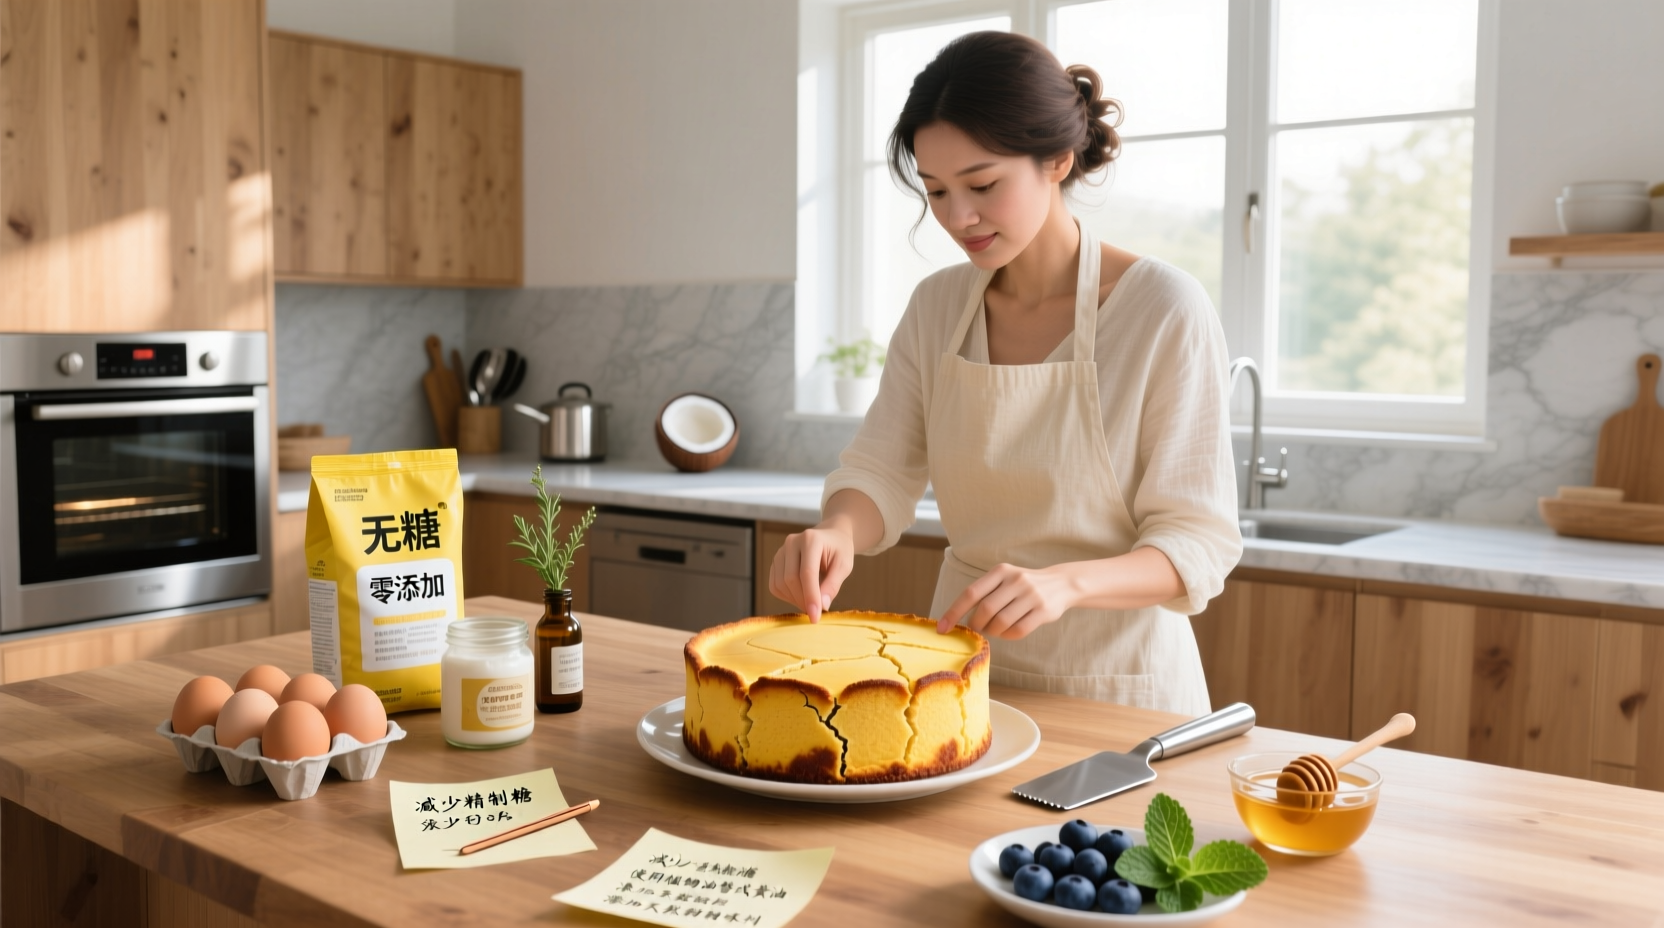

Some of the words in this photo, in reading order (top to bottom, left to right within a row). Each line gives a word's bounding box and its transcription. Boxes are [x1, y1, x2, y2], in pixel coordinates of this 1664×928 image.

[362, 508, 441, 555] 无糖
[370, 572, 445, 604] 零添加
[415, 786, 532, 813] 减少精制糖
